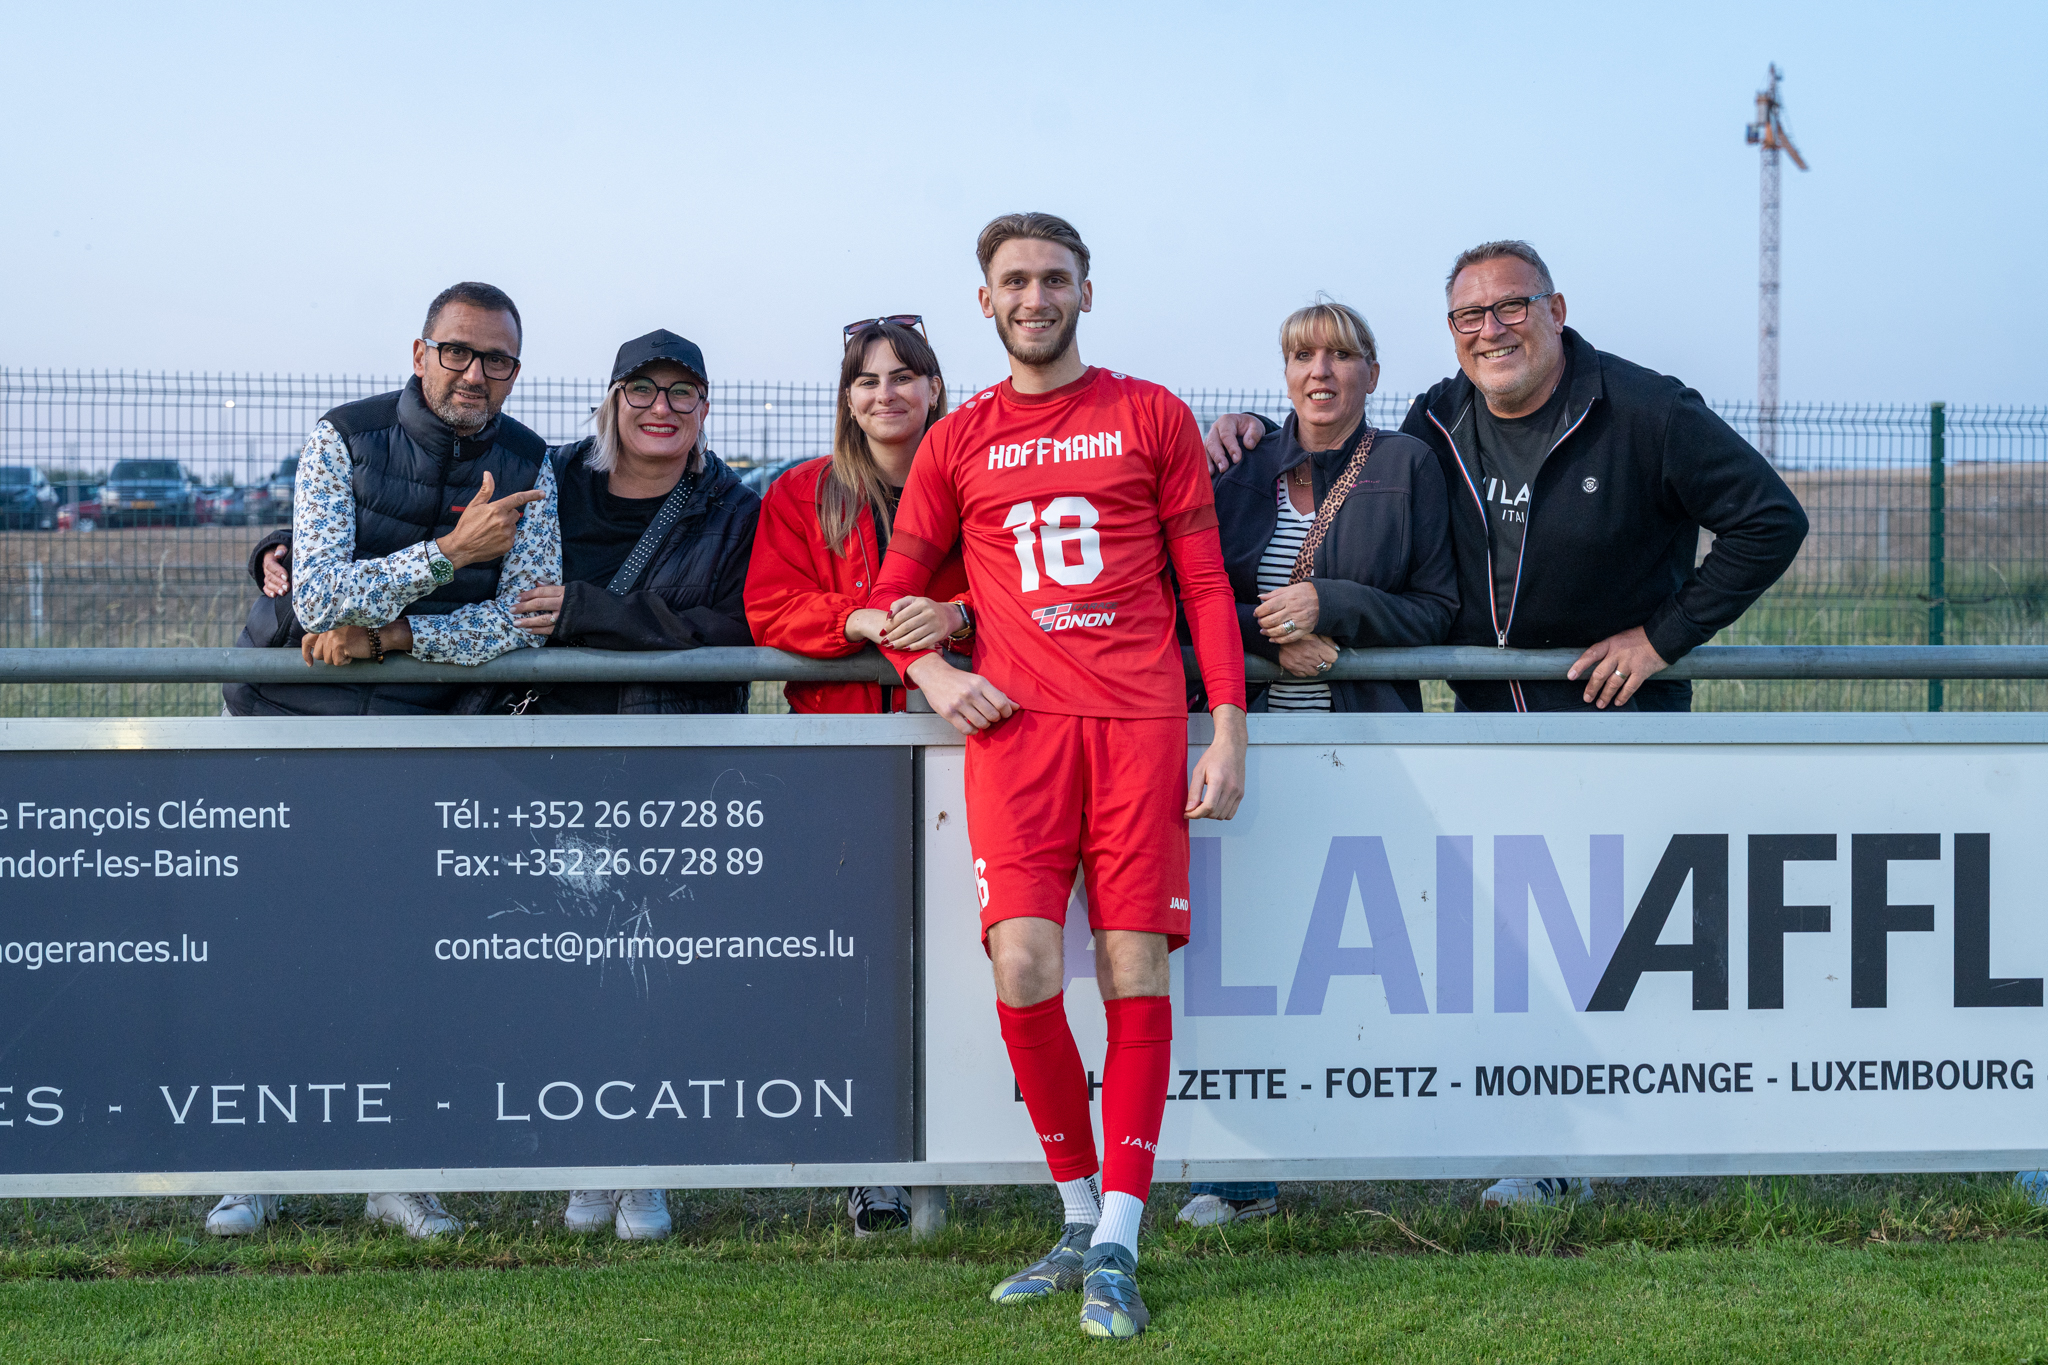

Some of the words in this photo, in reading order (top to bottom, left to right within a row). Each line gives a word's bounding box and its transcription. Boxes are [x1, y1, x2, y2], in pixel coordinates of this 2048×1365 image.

[988, 430, 1122, 470] HOFFMANN
[1483, 476, 1530, 506] ILA
[1072, 602, 1119, 611] GARAGE
[18, 801, 151, 837] François
[158, 798, 291, 830] Clément
[435, 798, 499, 829] Tél.:
[508, 800, 585, 829] +352
[594, 800, 631, 829] 26
[639, 800, 676, 828] 67
[681, 800, 718, 828] 28
[726, 799, 764, 828] 86
[437, 849, 499, 877] Fax:
[508, 848, 585, 877] +352
[594, 848, 631, 876] 26
[639, 848, 676, 876] 67
[681, 847, 718, 876] 28
[726, 847, 763, 875] 89
[1169, 896, 1189, 911] JAKO
[0, 934, 208, 970] ogerances.lu
[434, 930, 854, 965] contact@primogerances.lu
[1326, 1066, 1438, 1099] FOETZ
[1475, 1062, 1754, 1097] MONDERCANGE
[1791, 1059, 2034, 1091] LUXEMBOURG
[159, 1081, 392, 1125] VENTE
[496, 1078, 854, 1122] LOCATION
[1121, 1135, 1157, 1154] JAKO
